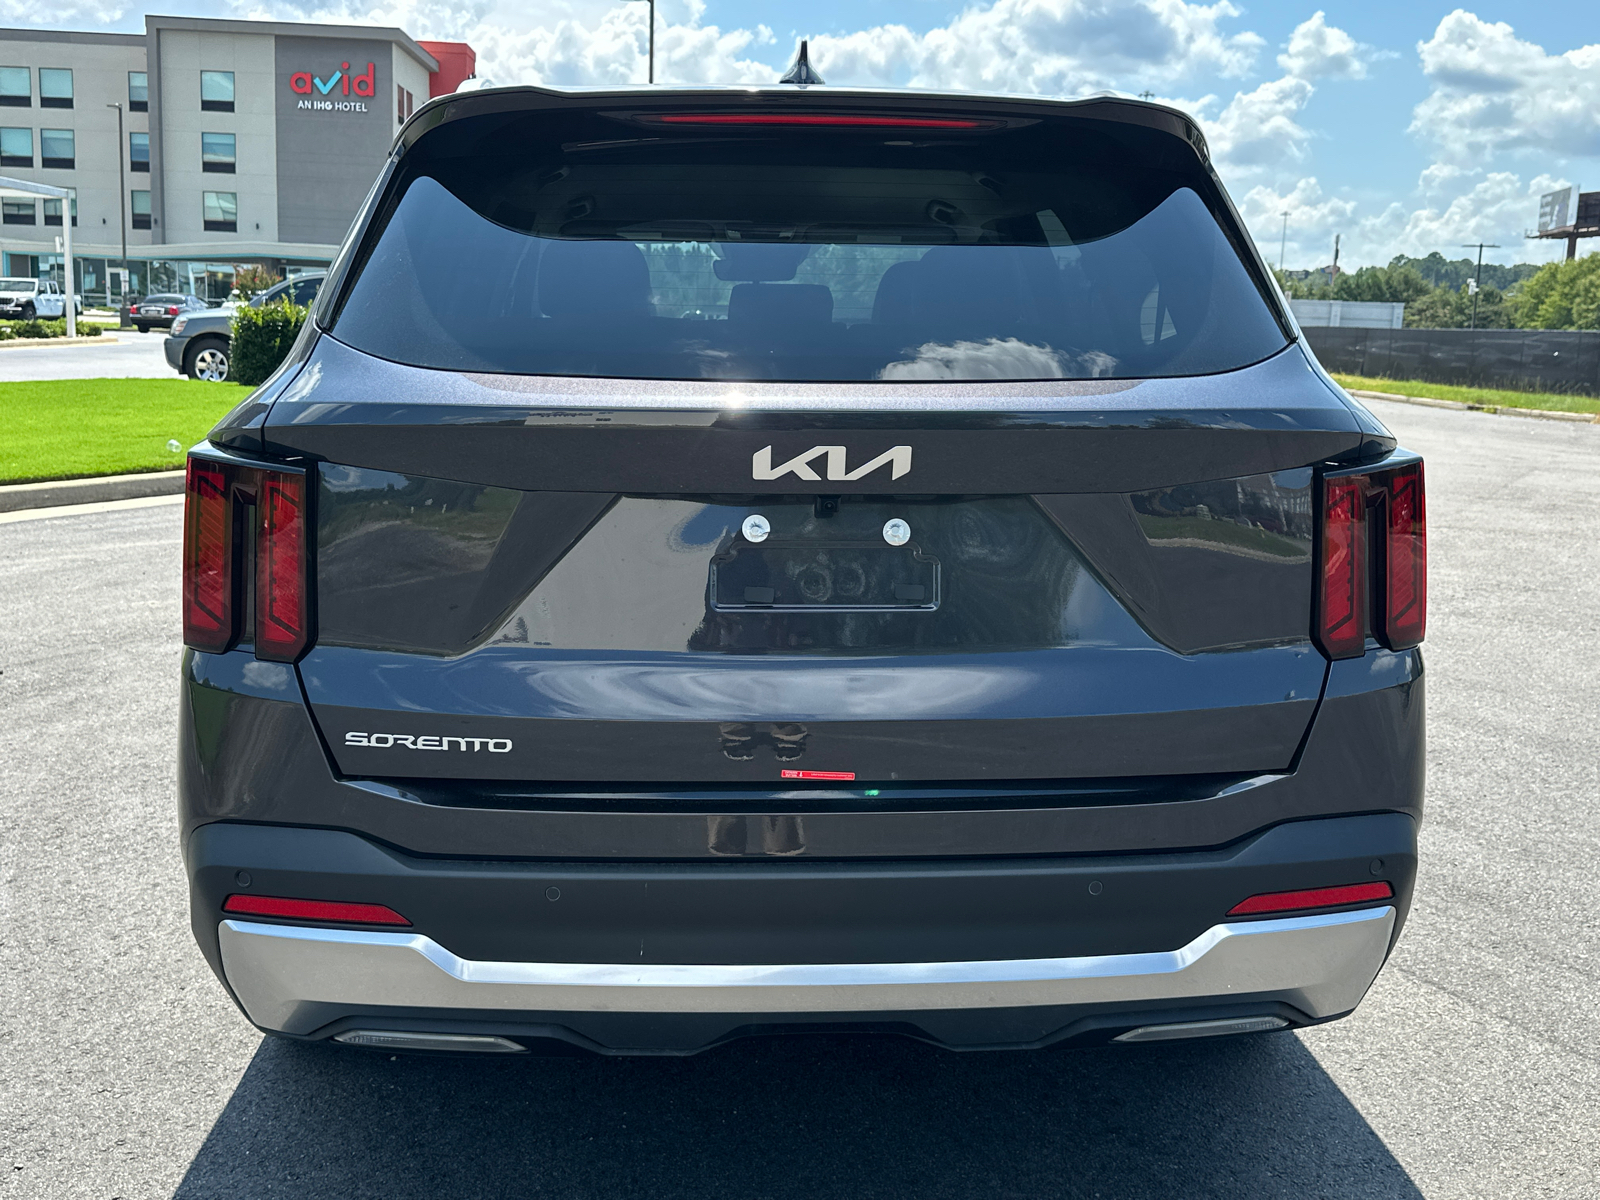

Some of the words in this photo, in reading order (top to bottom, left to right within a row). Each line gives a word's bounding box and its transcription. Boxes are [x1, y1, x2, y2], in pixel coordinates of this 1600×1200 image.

[290, 61, 375, 97] avid
[297, 100, 312, 110] AN
[313, 100, 333, 111] IHG
[334, 101, 368, 112] HOTEL
[752, 445, 912, 481] KIA
[345, 732, 513, 753] SORENTO
